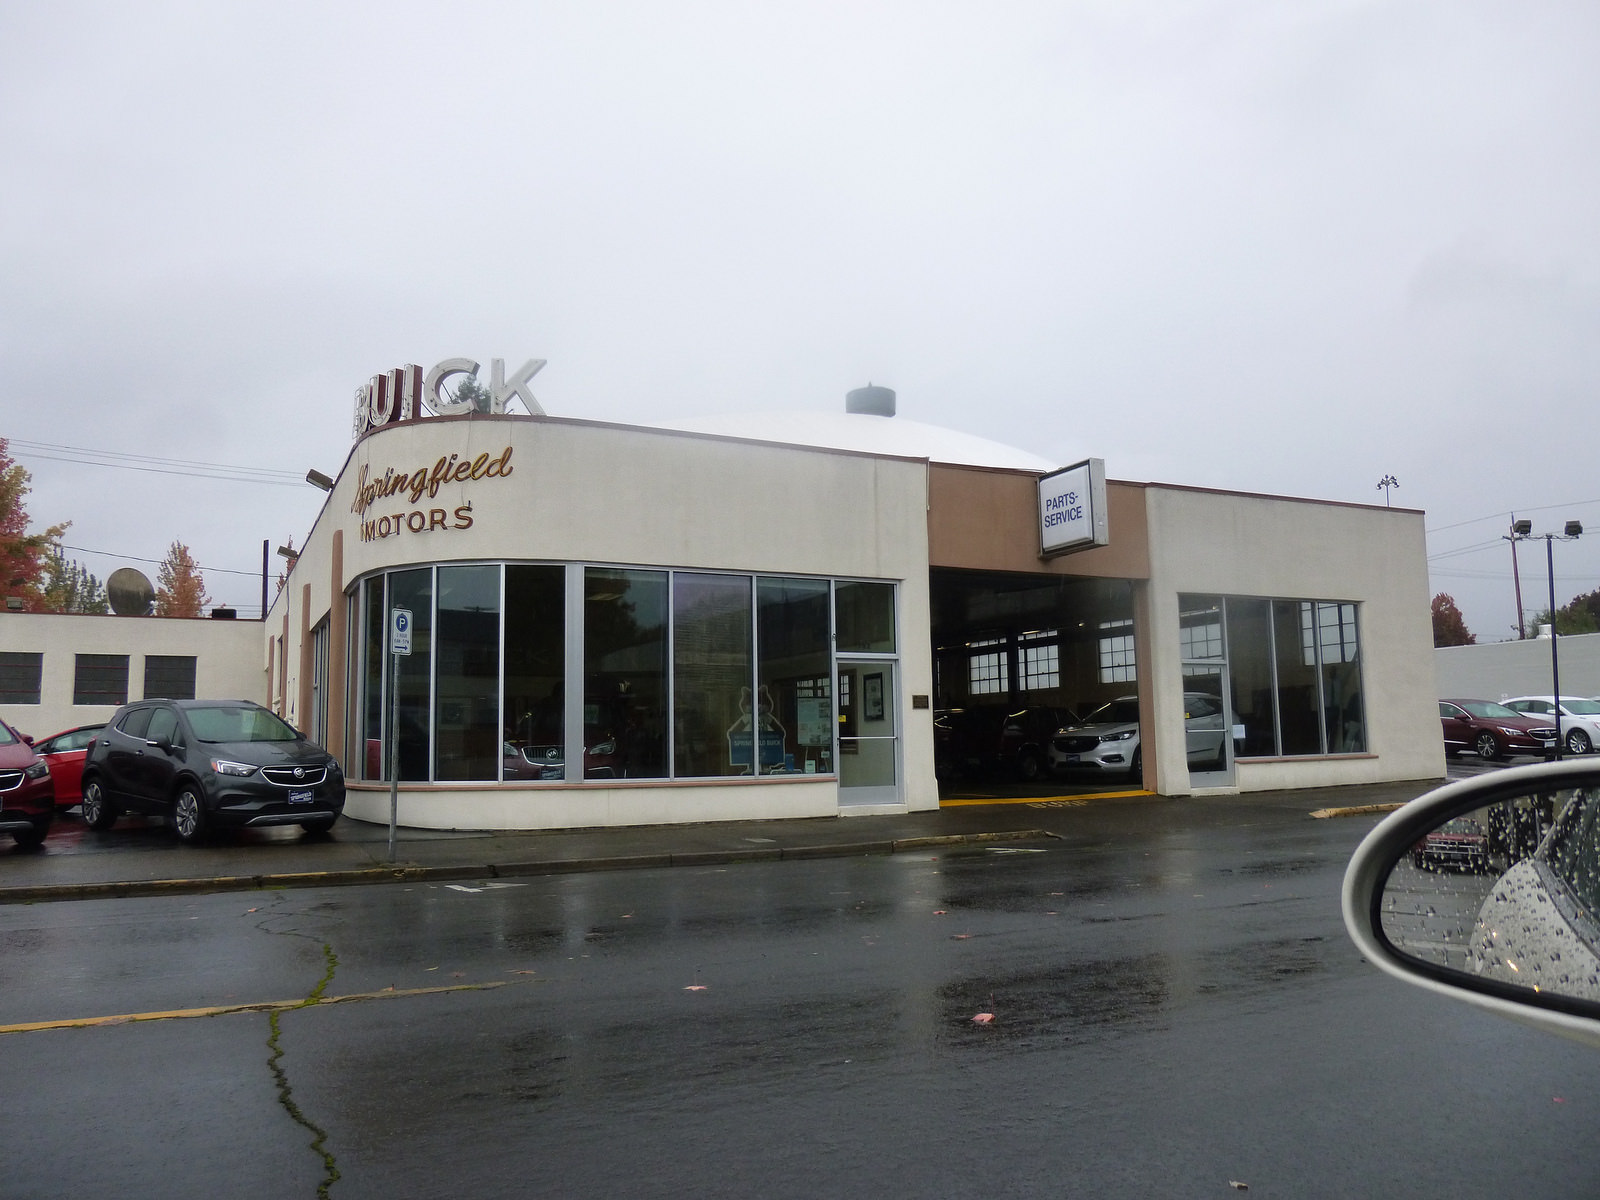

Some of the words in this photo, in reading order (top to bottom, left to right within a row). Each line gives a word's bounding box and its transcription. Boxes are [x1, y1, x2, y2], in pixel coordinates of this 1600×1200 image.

[352, 358, 547, 439] BUICK
[351, 447, 513, 515] Springfield
[1046, 492, 1079, 512] PARTS-
[360, 506, 473, 543] MOTORS
[1044, 506, 1083, 528] SERVICE
[399, 617, 406, 629] P
